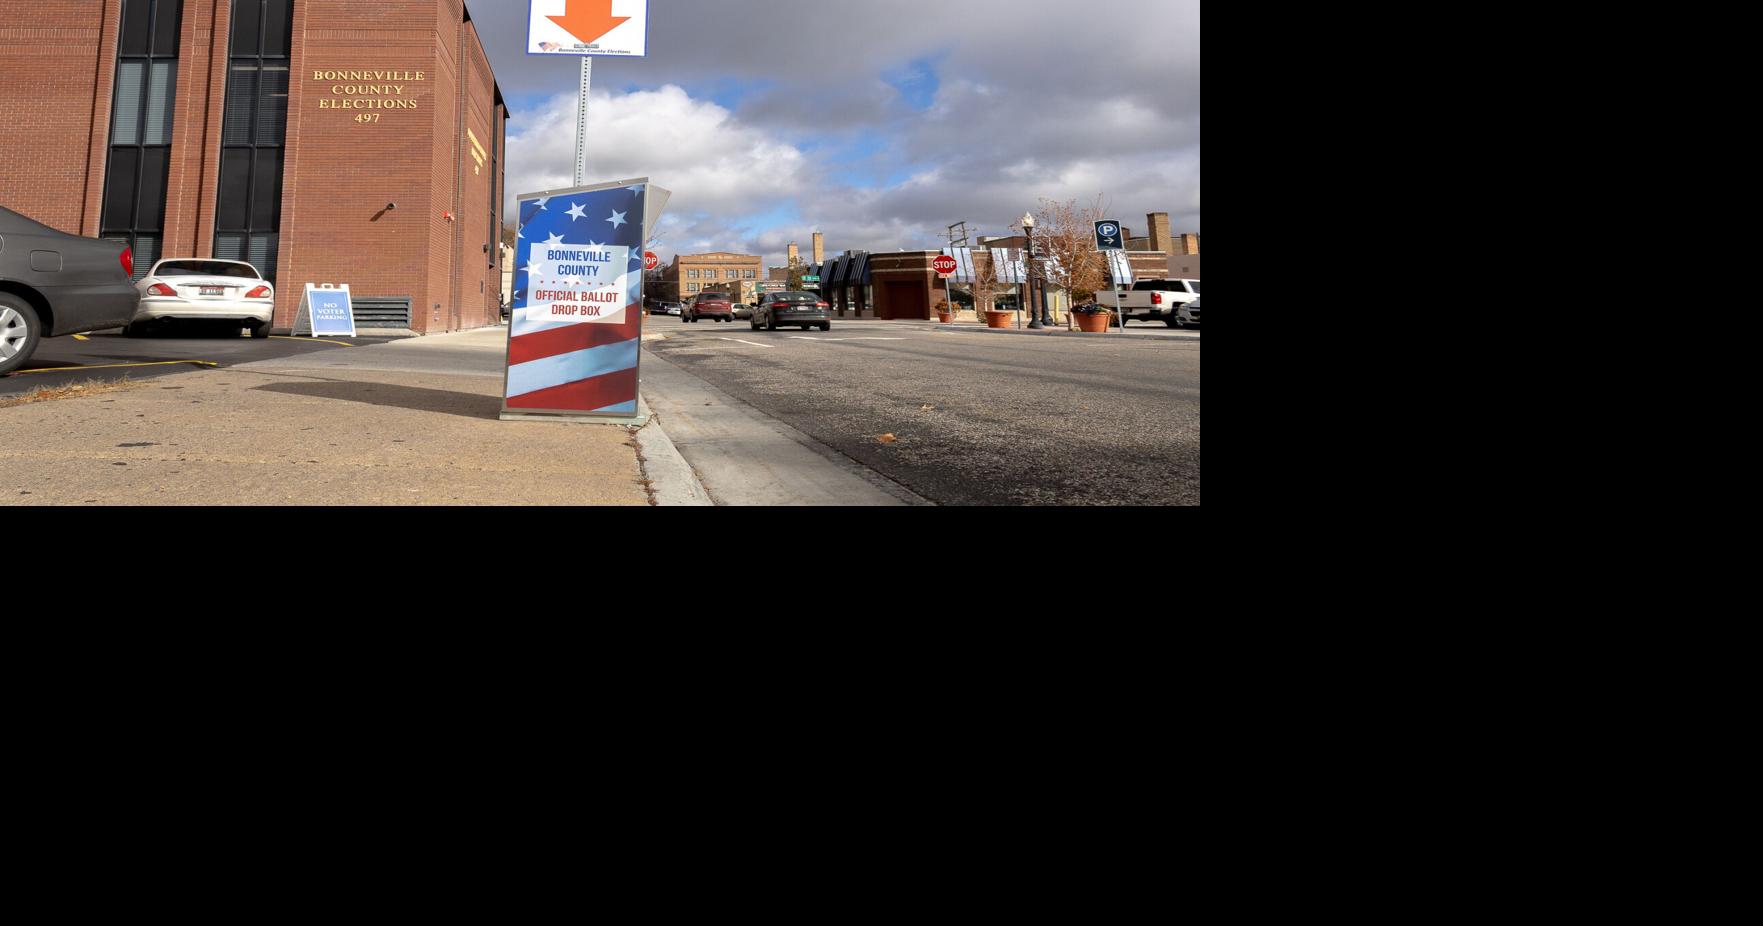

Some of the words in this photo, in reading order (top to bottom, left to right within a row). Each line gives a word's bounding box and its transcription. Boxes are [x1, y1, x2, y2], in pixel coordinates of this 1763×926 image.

[313, 70, 425, 81] BONNEVILLE
[332, 85, 404, 95] COUNTY
[319, 99, 417, 109] ELECTIONS
[354, 113, 380, 123] 497
[1103, 225, 1114, 235] P
[547, 249, 611, 262] BONNEVILLE
[644, 256, 657, 265] OP
[933, 260, 956, 269] STOP
[558, 264, 599, 276] COUNTY
[535, 289, 579, 302] OFFICIAL
[581, 291, 619, 303] BALLOT
[551, 304, 578, 316] DROP
[580, 305, 601, 316] BOX
